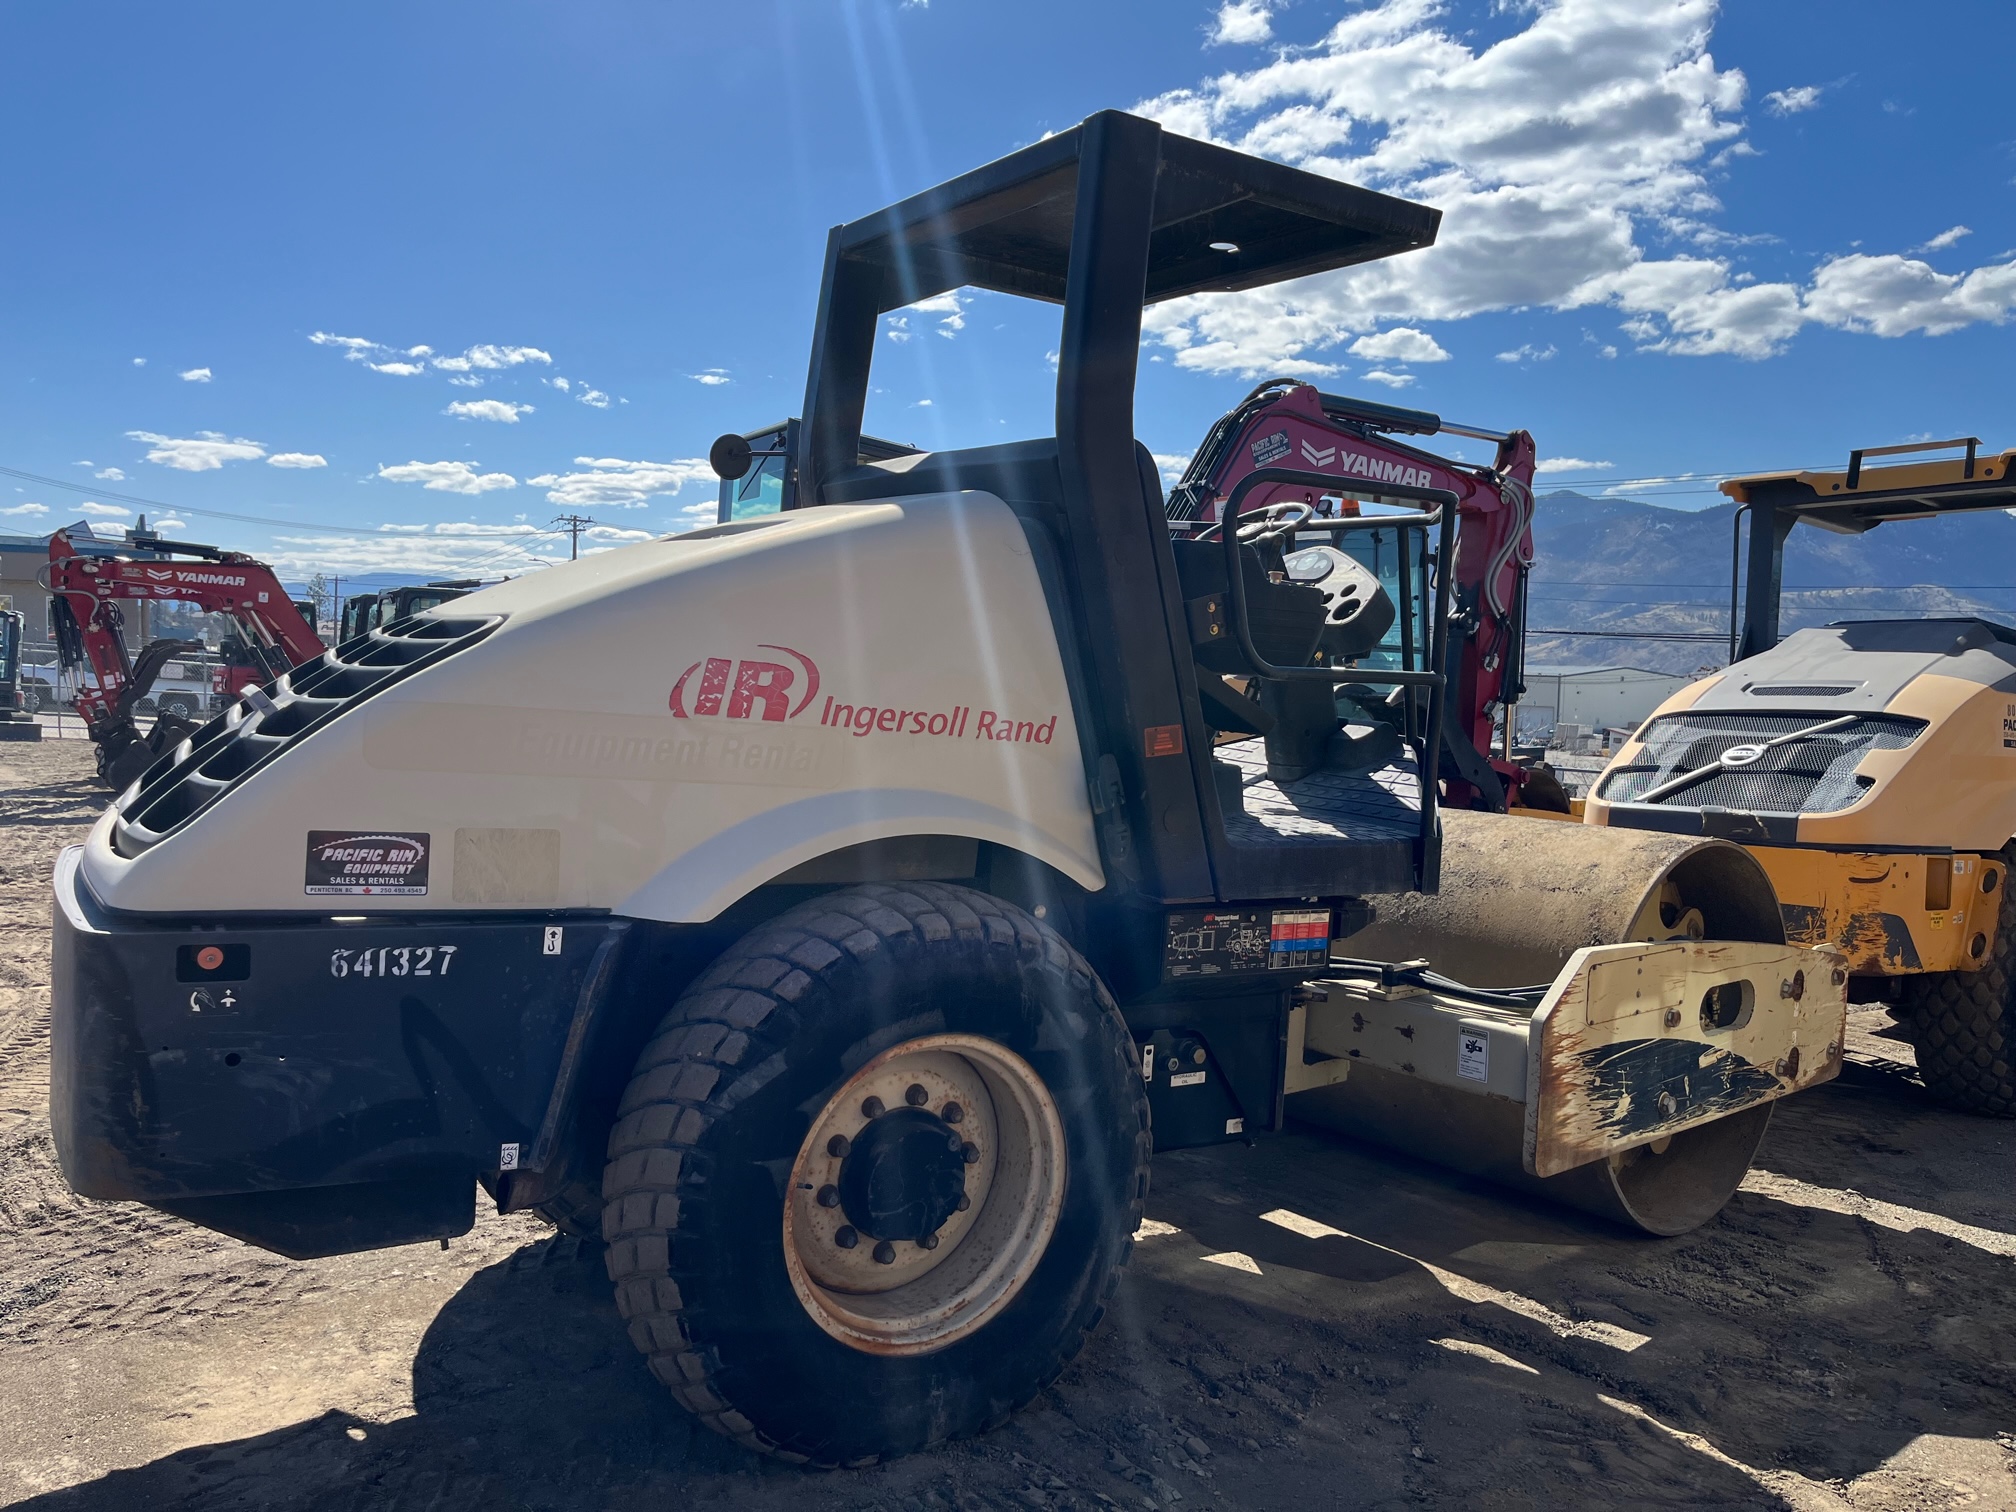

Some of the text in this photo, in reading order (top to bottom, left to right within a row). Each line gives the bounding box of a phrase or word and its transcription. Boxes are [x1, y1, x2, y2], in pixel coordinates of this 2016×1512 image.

[1341, 450, 1432, 488] YANMAR
[176, 571, 246, 587] YANMAR
[694, 658, 795, 722] IR
[820, 695, 1057, 745] Ingersoll Rand
[517, 721, 826, 772] Equipment Rental
[321, 848, 416, 862] PACIFIC RIM
[343, 863, 415, 875] EQUIPMENT
[330, 876, 356, 885] SALES
[368, 877, 405, 885] RENTALS
[331, 945, 457, 978] 641327
